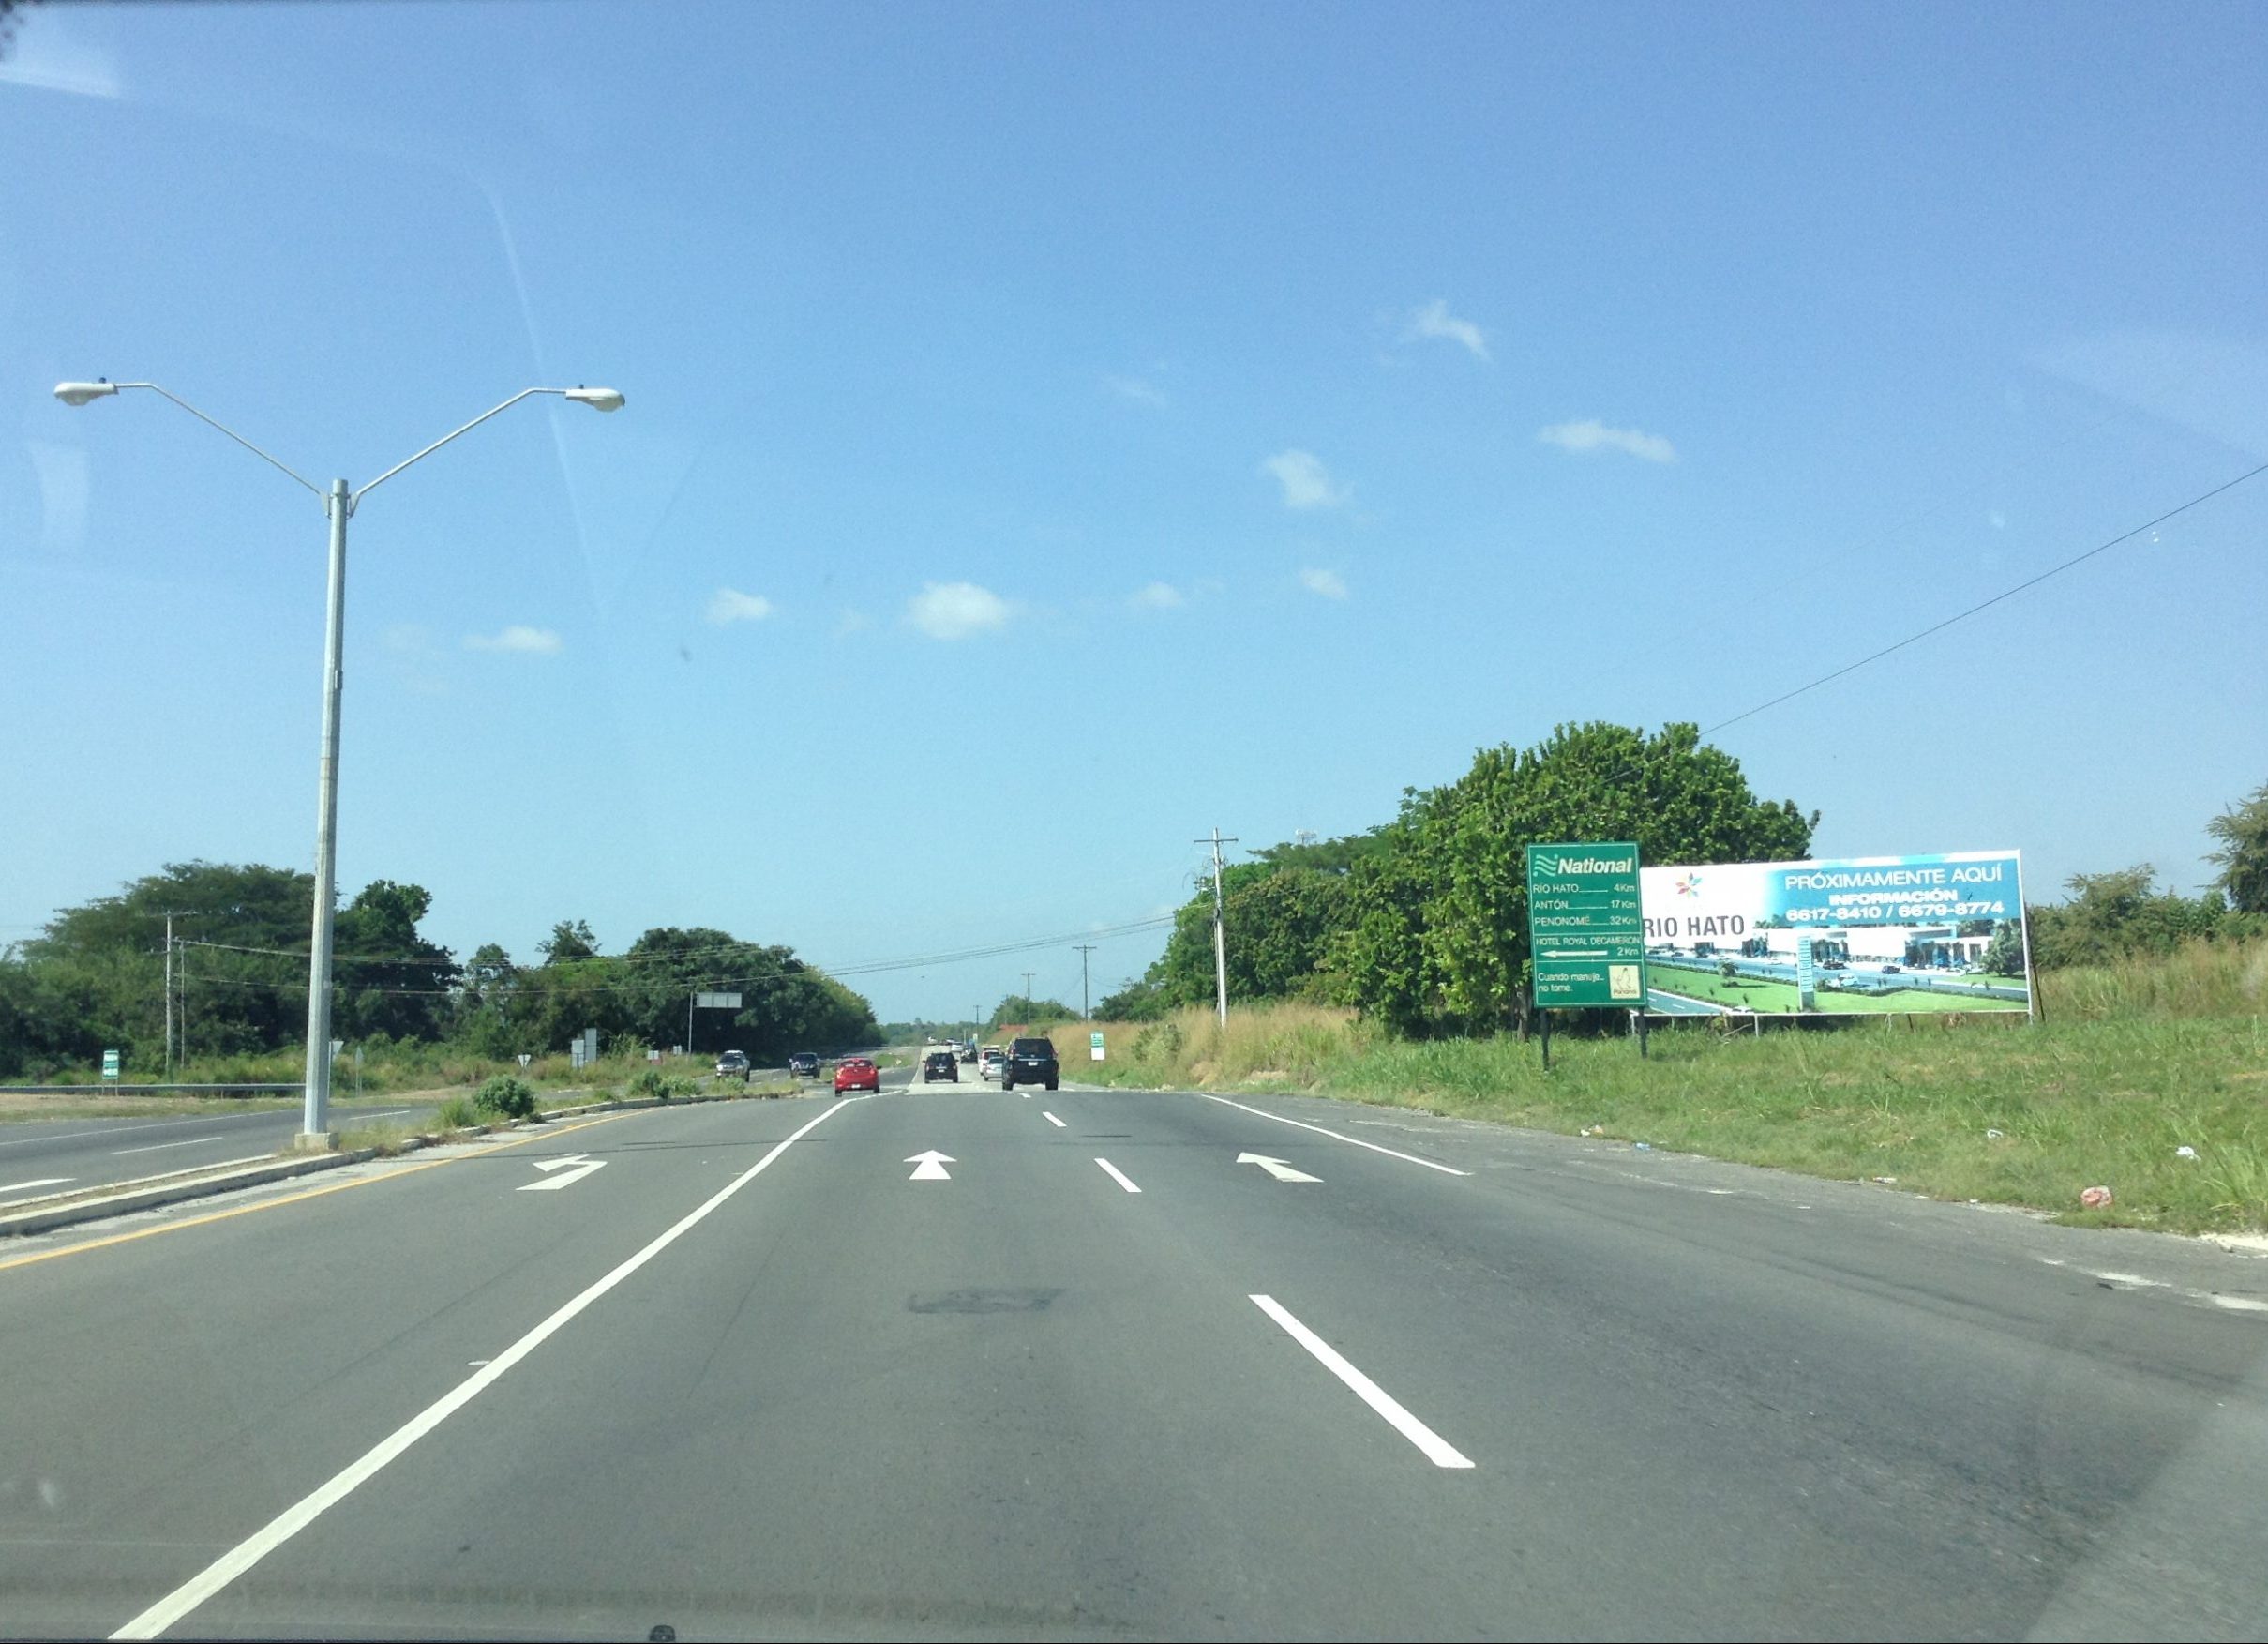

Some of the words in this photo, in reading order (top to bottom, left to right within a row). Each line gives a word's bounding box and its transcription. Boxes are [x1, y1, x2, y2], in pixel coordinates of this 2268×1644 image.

[1558, 857, 1632, 874] National
[1784, 868, 1946, 890] PRÓXIMAMENTE
[1951, 863, 2003, 883] AQUÍ
[1553, 883, 1579, 893] HATO
[1829, 887, 1959, 906] INFORMACIÓN
[1534, 899, 1568, 910] ANTÓN
[1886, 905, 1893, 918] /
[1535, 915, 1590, 926] PENONOMÉ
[1643, 917, 1677, 938] RIO
[1687, 915, 1745, 936] HATO
[1536, 938, 1560, 946] HOTEL
[1563, 937, 1587, 945] ROYAL
[1590, 936, 1640, 945] DECAMERON
[1538, 973, 1569, 982] Cuando
